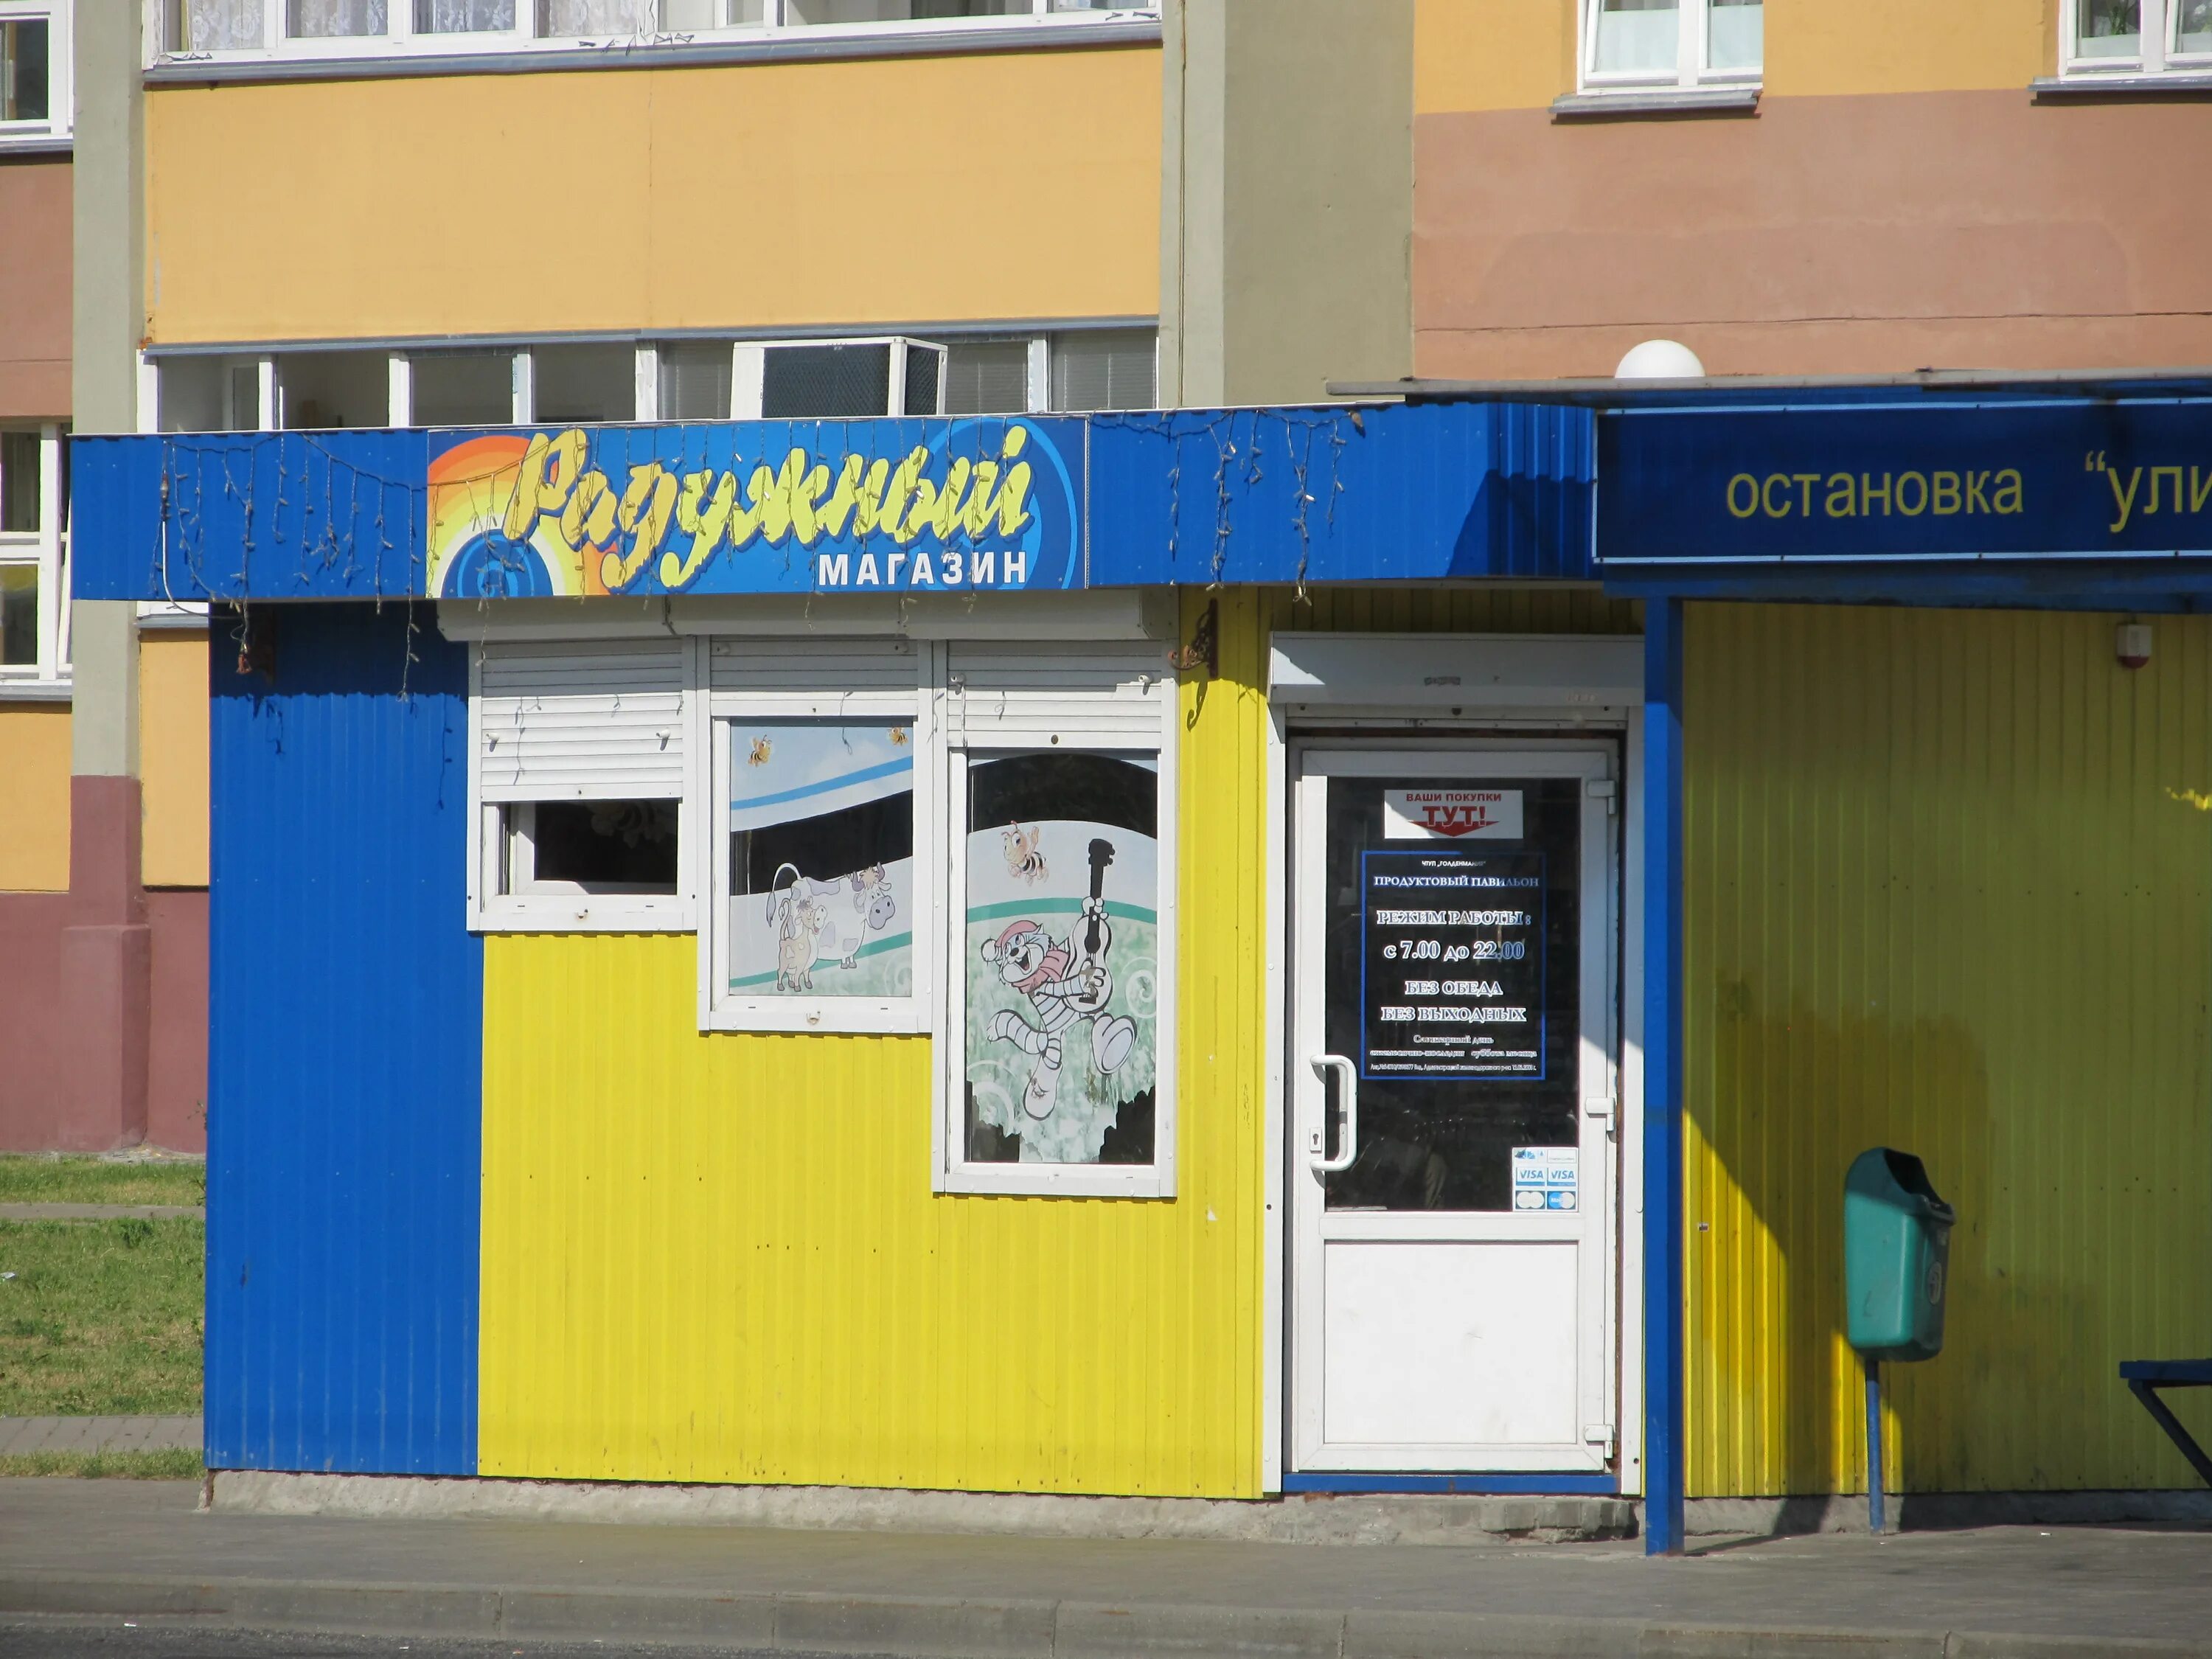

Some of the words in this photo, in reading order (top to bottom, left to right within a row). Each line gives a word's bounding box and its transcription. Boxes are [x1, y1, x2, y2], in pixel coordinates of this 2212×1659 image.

[1725, 467, 2025, 519] остановка
[504, 425, 1034, 588] Радужный
[818, 552, 1026, 585] МАГАЗИН
[1406, 793, 1442, 802] ВАШИ
[1446, 793, 1502, 802] ПОКУПКИ
[1422, 805, 1486, 827] ТУТ!
[1374, 874, 1470, 887] ПРОДУКТОВЫЙ
[1471, 877, 1539, 887] ПАВИЛЬОН
[1377, 910, 1447, 925] РЕЖИМ
[1384, 945, 1397, 959] с
[1400, 940, 1441, 959] 7.00
[1444, 945, 1470, 961] до
[1473, 940, 1525, 959] 22.00
[1405, 981, 1440, 995] БЕЗ
[1442, 981, 1503, 997] ОБЕДА
[1381, 1006, 1416, 1021] БЕЗ
[1418, 1006, 1527, 1023] ВЫХОДНЫХ
[1520, 1170, 1544, 1179] VISA
[1551, 1170, 1575, 1179] VISA
